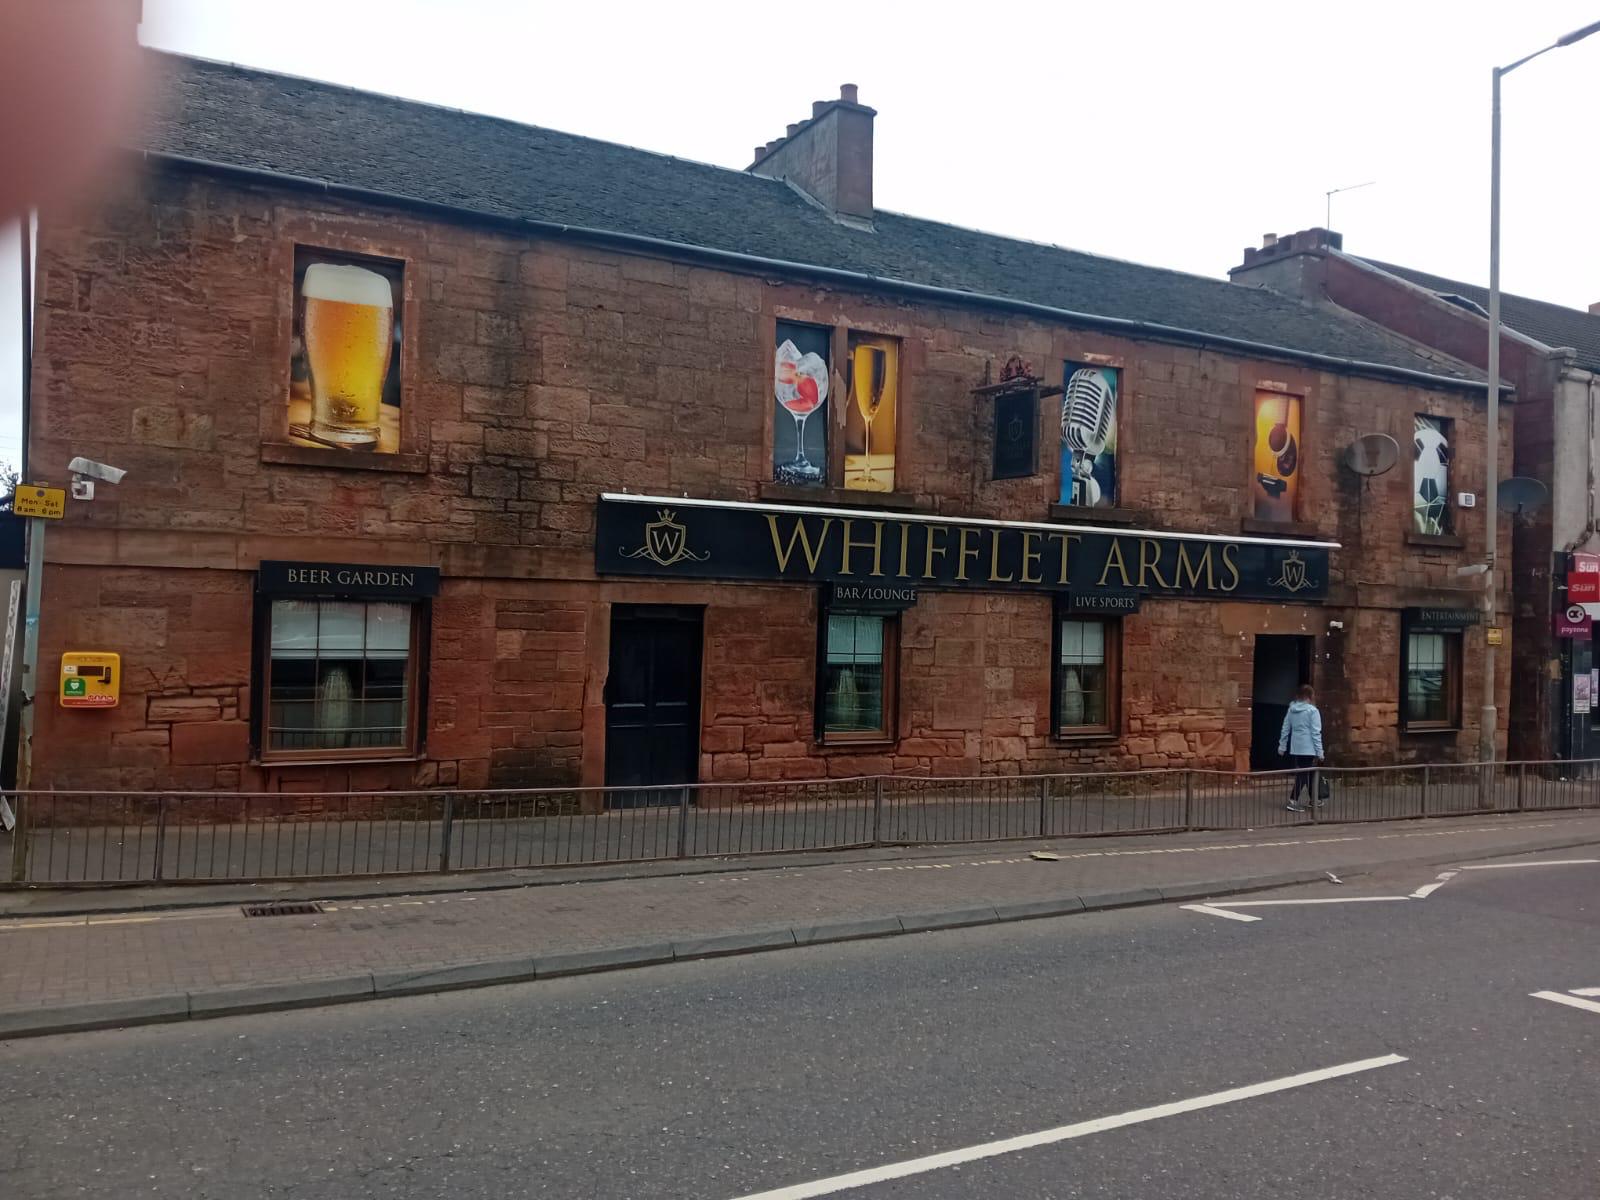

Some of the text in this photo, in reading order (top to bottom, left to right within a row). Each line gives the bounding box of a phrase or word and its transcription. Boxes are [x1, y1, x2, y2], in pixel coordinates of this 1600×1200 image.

[651, 530, 680, 554] W
[763, 514, 1240, 592] WHIFFLET ARMS
[288, 568, 414, 586] BEER GARDEN
[1286, 565, 1302, 583] W
[837, 586, 916, 601] BAR/LOUNGE
[1076, 596, 1135, 609] LIVE SPORTS
